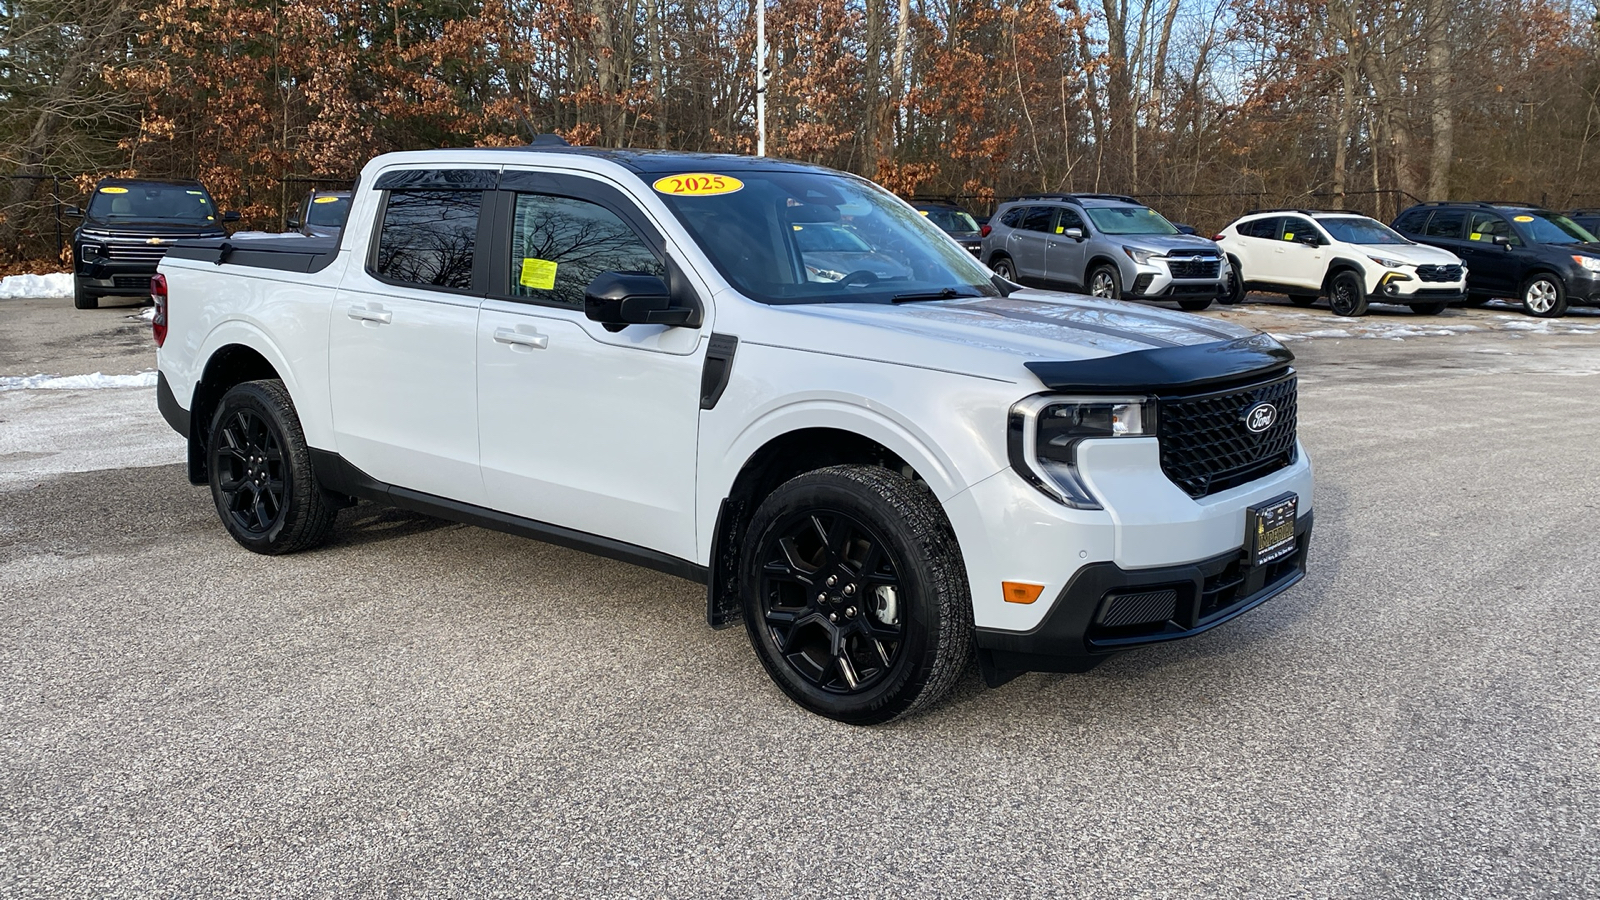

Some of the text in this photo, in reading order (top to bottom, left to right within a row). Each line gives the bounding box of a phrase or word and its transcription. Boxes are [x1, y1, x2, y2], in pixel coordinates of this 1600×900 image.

[670, 176, 726, 193] 2025
[1252, 407, 1273, 429] Ford
[1257, 520, 1295, 551] IMPERIAL
